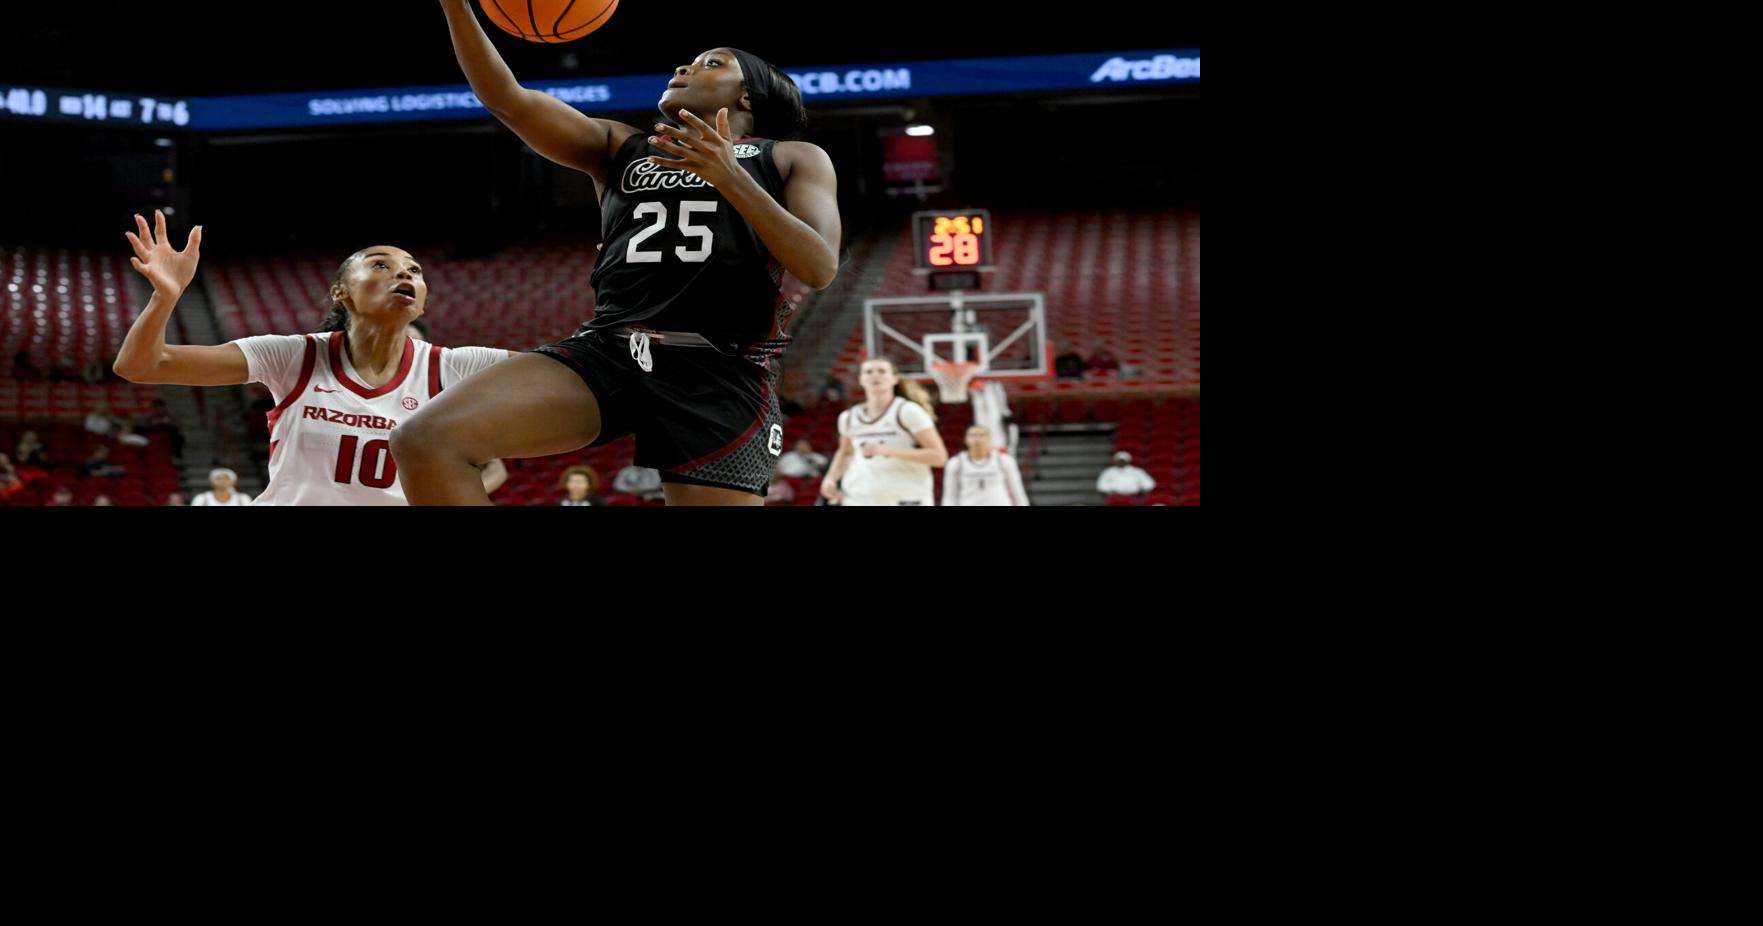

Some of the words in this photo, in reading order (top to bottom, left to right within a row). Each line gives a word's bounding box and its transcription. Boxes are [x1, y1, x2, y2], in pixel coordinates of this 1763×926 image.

[308, 97, 389, 115] SOLVING
[626, 200, 718, 263] 25
[929, 233, 979, 266] 28
[334, 434, 397, 489] 10
